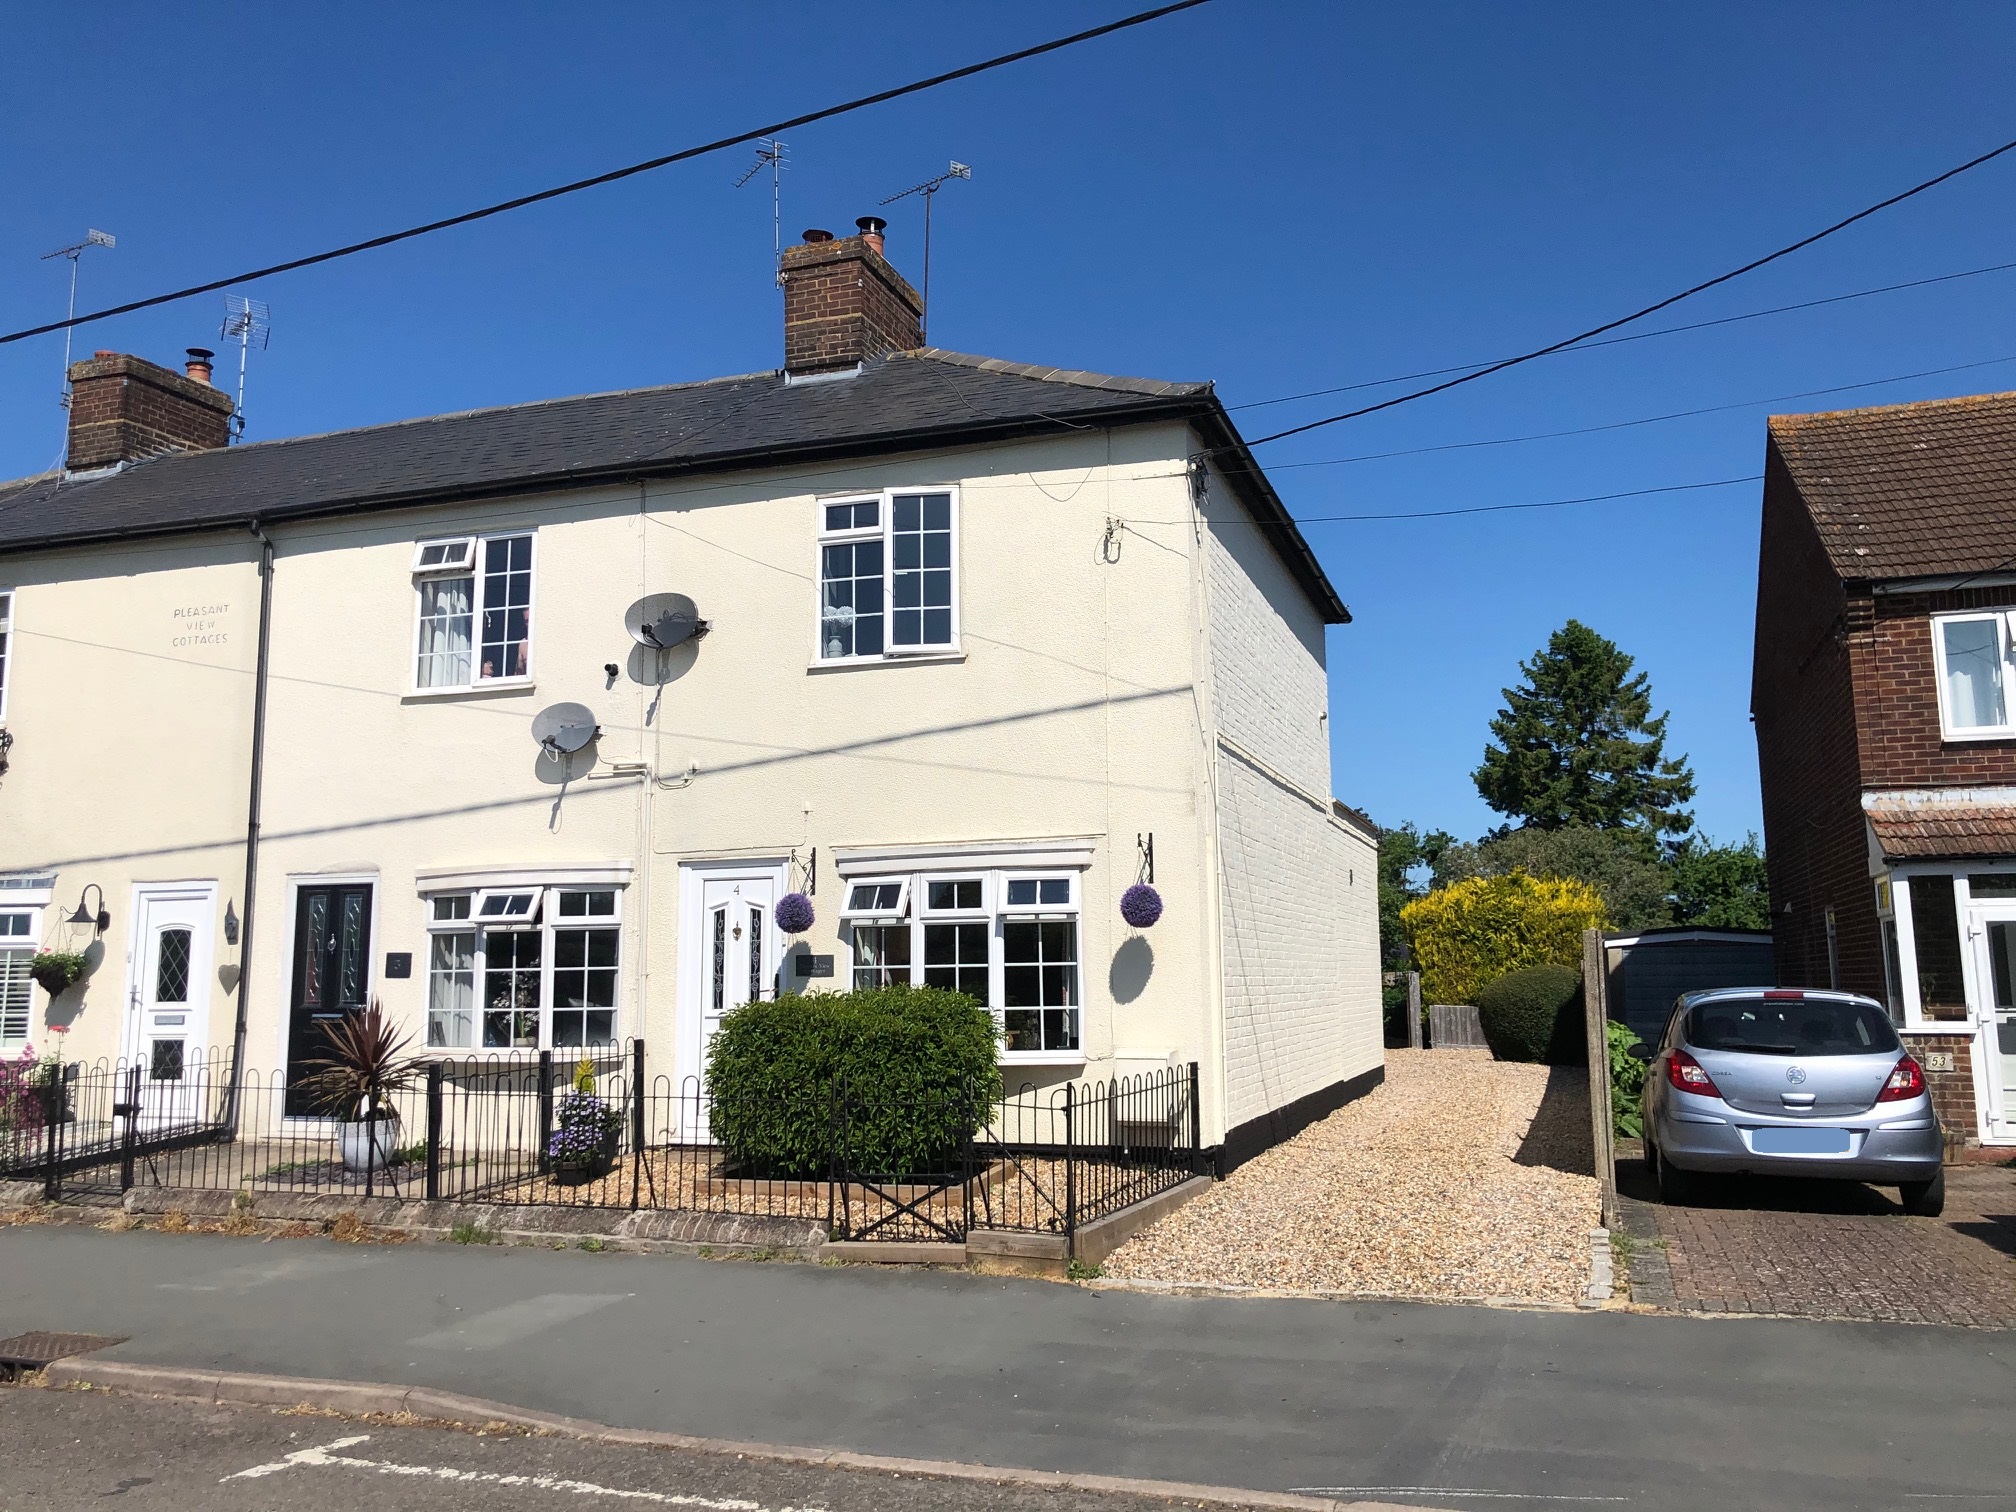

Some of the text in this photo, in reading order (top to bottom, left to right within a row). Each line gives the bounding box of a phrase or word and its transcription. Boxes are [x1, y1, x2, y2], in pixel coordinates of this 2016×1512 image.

[173, 604, 230, 619] PLEASANT
[186, 620, 216, 631] VIEW
[172, 633, 228, 647] COTTAGES
[733, 884, 740, 896] 4
[1931, 1056, 1946, 1067] 53
